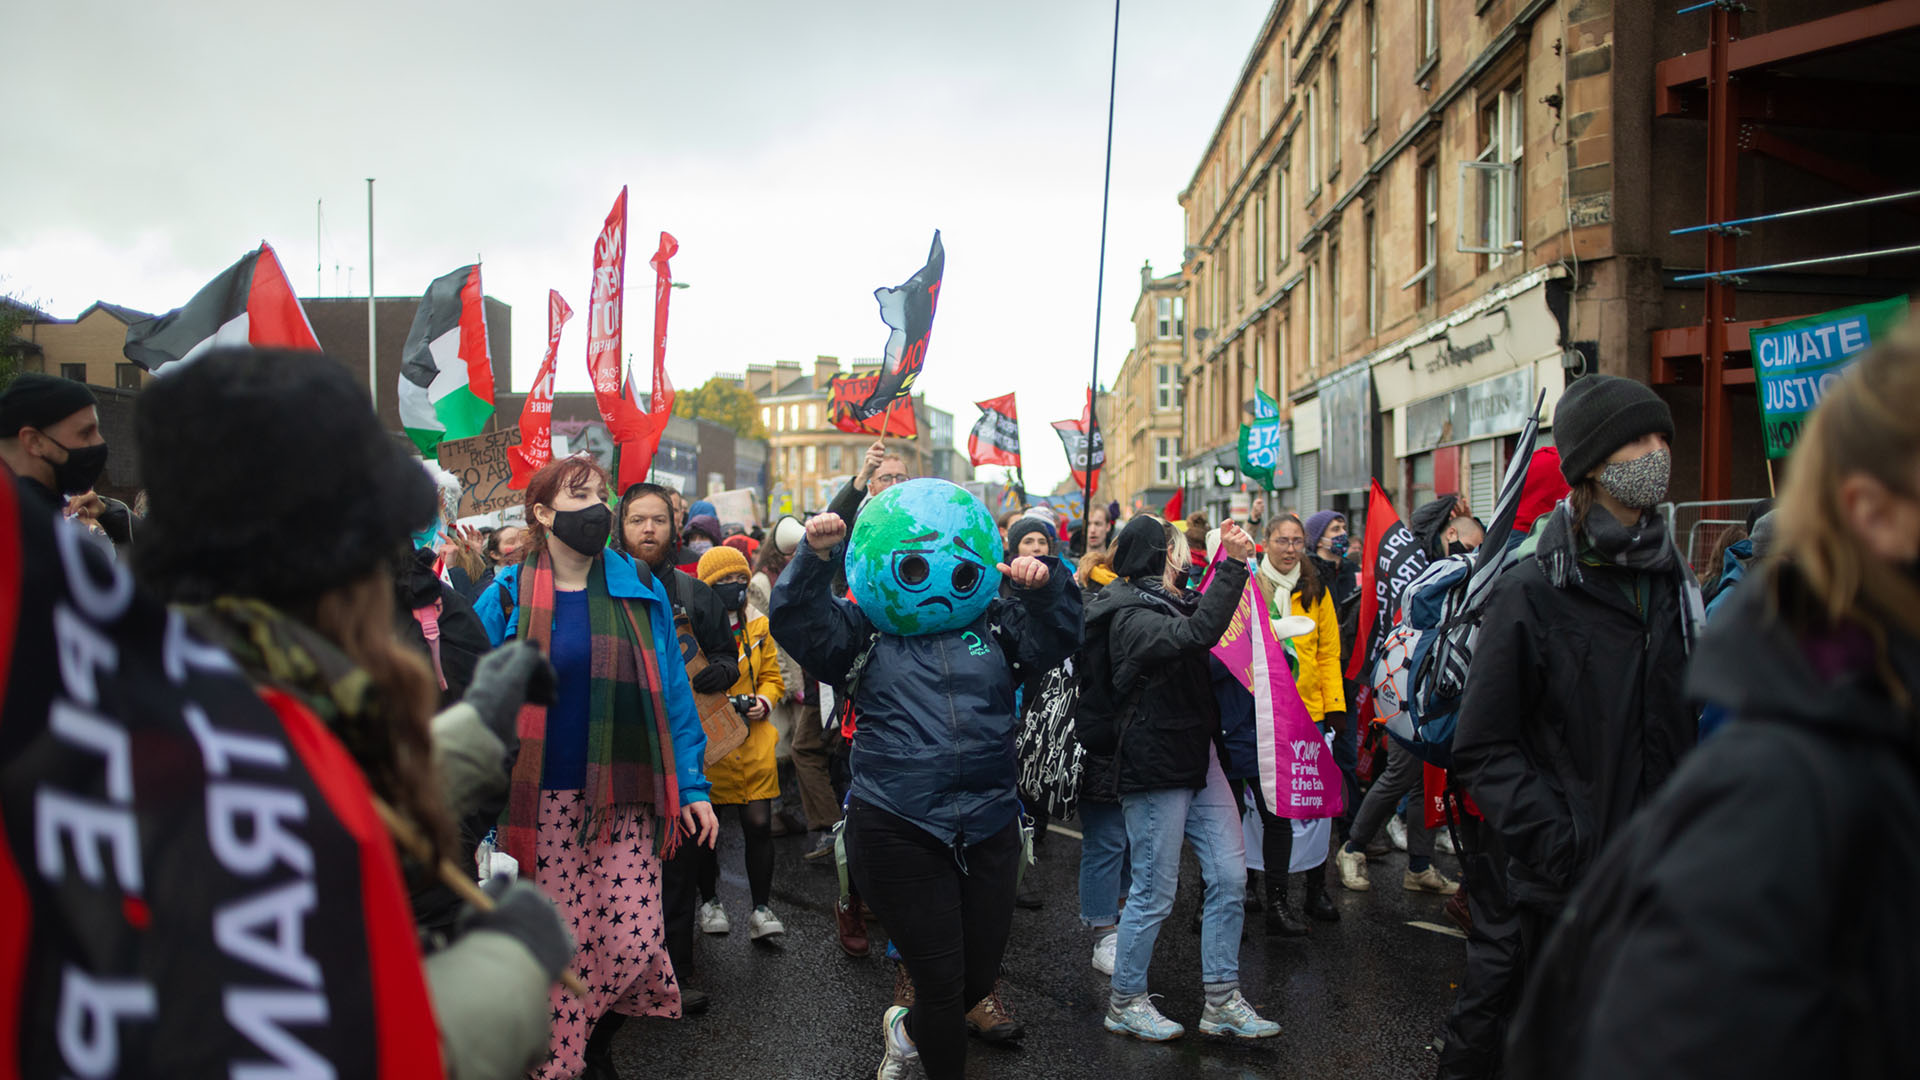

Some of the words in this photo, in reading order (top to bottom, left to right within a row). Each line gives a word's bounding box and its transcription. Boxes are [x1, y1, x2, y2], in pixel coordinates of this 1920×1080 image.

[1759, 320, 1865, 368] CLIMATE
[442, 438, 477, 457] THE
[470, 447, 508, 466] RISIN
[1291, 777, 1312, 790] the
